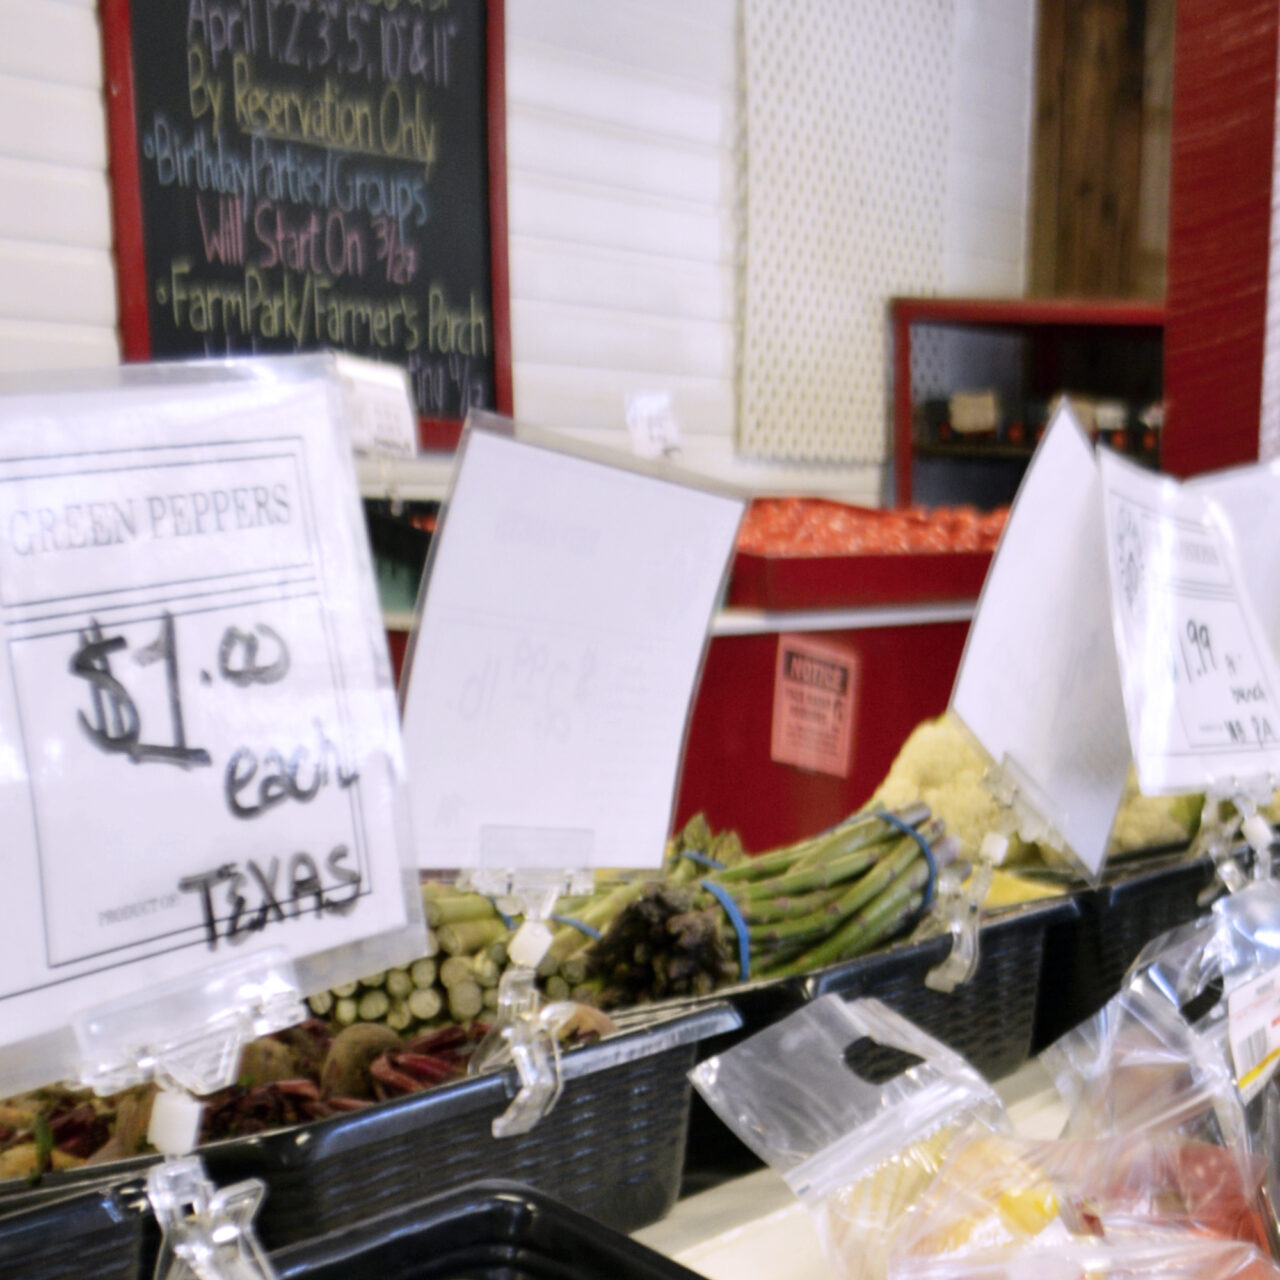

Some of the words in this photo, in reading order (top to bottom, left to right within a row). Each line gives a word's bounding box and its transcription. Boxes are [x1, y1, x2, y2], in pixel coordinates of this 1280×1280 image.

[187, 46, 221, 142] By
[233, 52, 373, 150] Reservation
[379, 82, 435, 182] Only
[197, 195, 243, 267] Will
[254, 200, 322, 275] Start
[325, 208, 363, 278] On
[10, 504, 139, 556] GREEN
[149, 483, 292, 541] PEPPERS
[69, 608, 290, 771] $1.00
[224, 719, 361, 821] each
[178, 844, 363, 951] TEXAS
